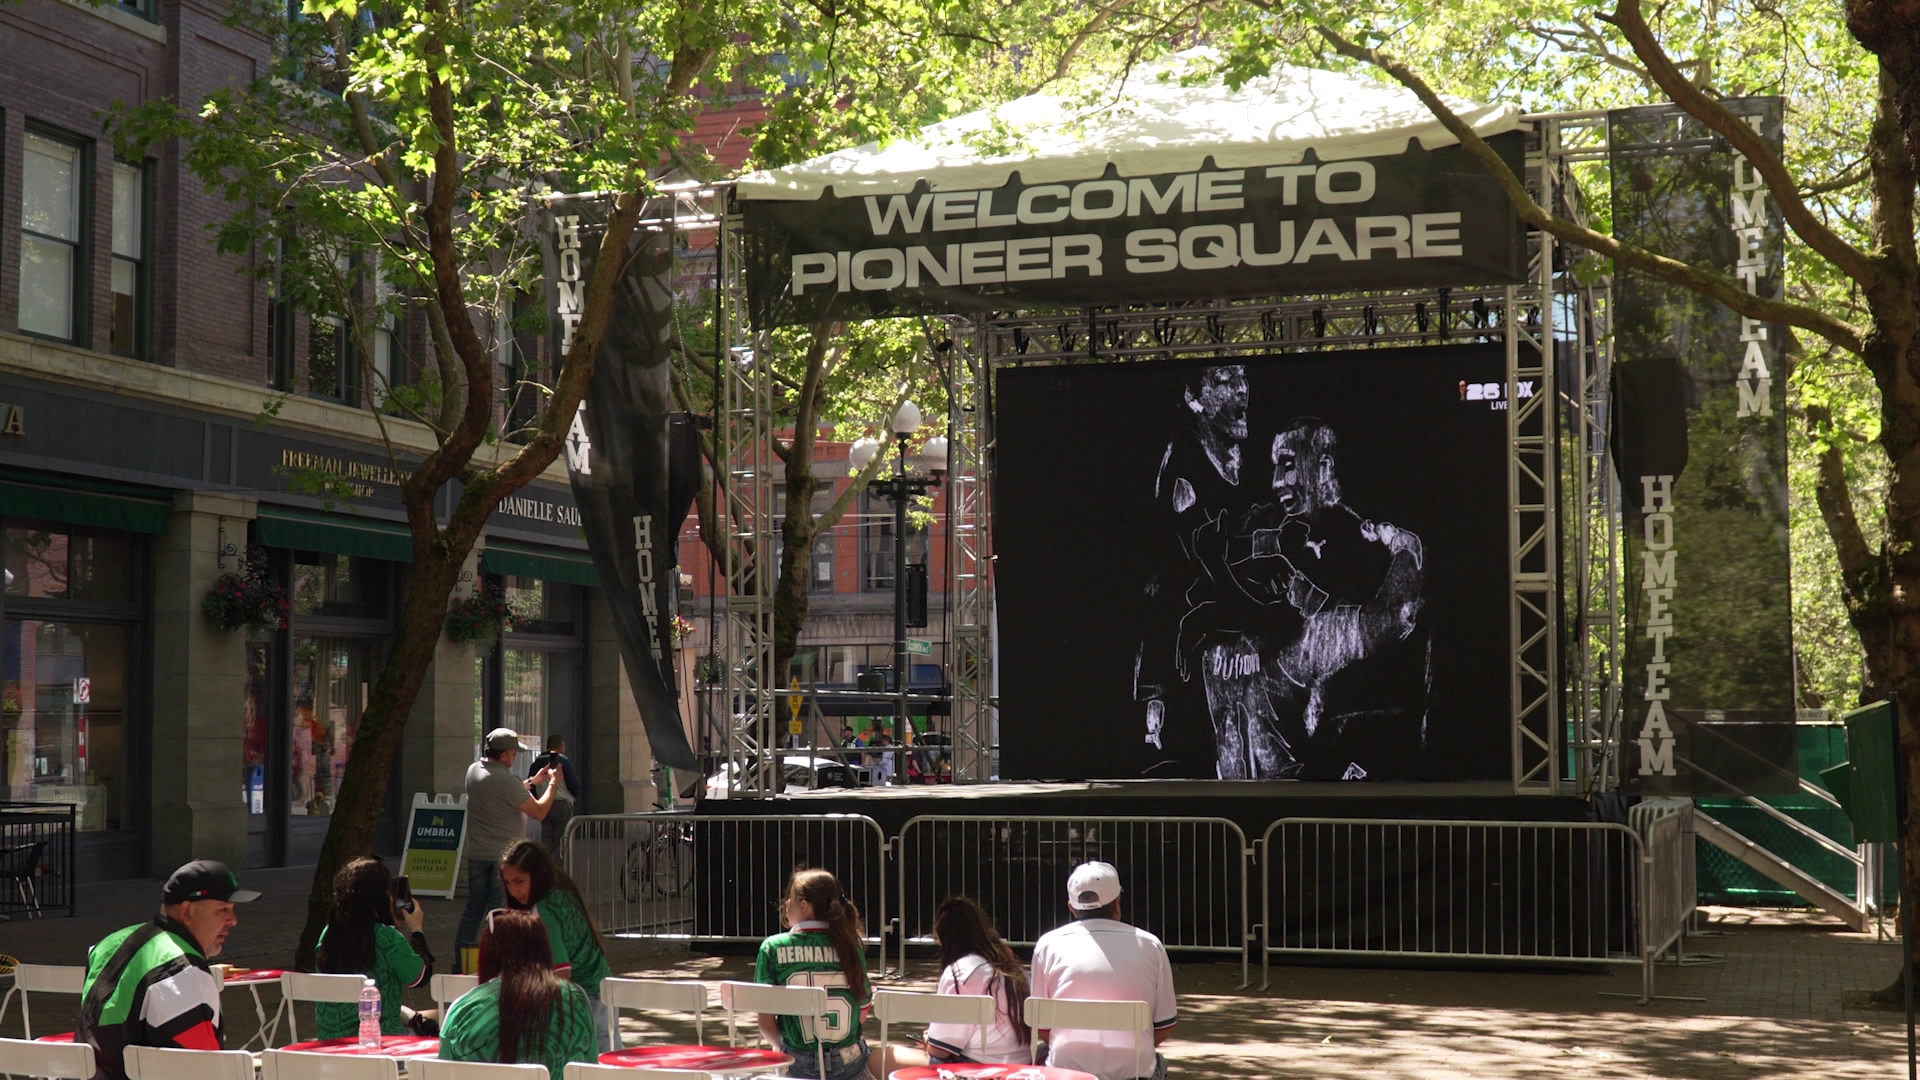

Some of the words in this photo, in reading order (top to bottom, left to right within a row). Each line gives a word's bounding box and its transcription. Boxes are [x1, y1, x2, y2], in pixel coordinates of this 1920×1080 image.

[864, 169, 1245, 236] WELCOME
[1265, 160, 1376, 206] TO
[791, 233, 1103, 296] PIONEER
[1125, 212, 1463, 274] SQUARE
[555, 215, 591, 475] HOMEAM
[1466, 382, 1500, 400] 26
[1504, 381, 1534, 398] OX
[4, 406, 25, 435] A
[281, 449, 342, 476] FREEMAN
[324, 481, 375, 498] WOSHOP
[498, 495, 554, 522] DANIELLE
[1638, 475, 1677, 776] HOMETEAM
[417, 827, 455, 837] UMBRIA
[785, 971, 852, 1044] 15
